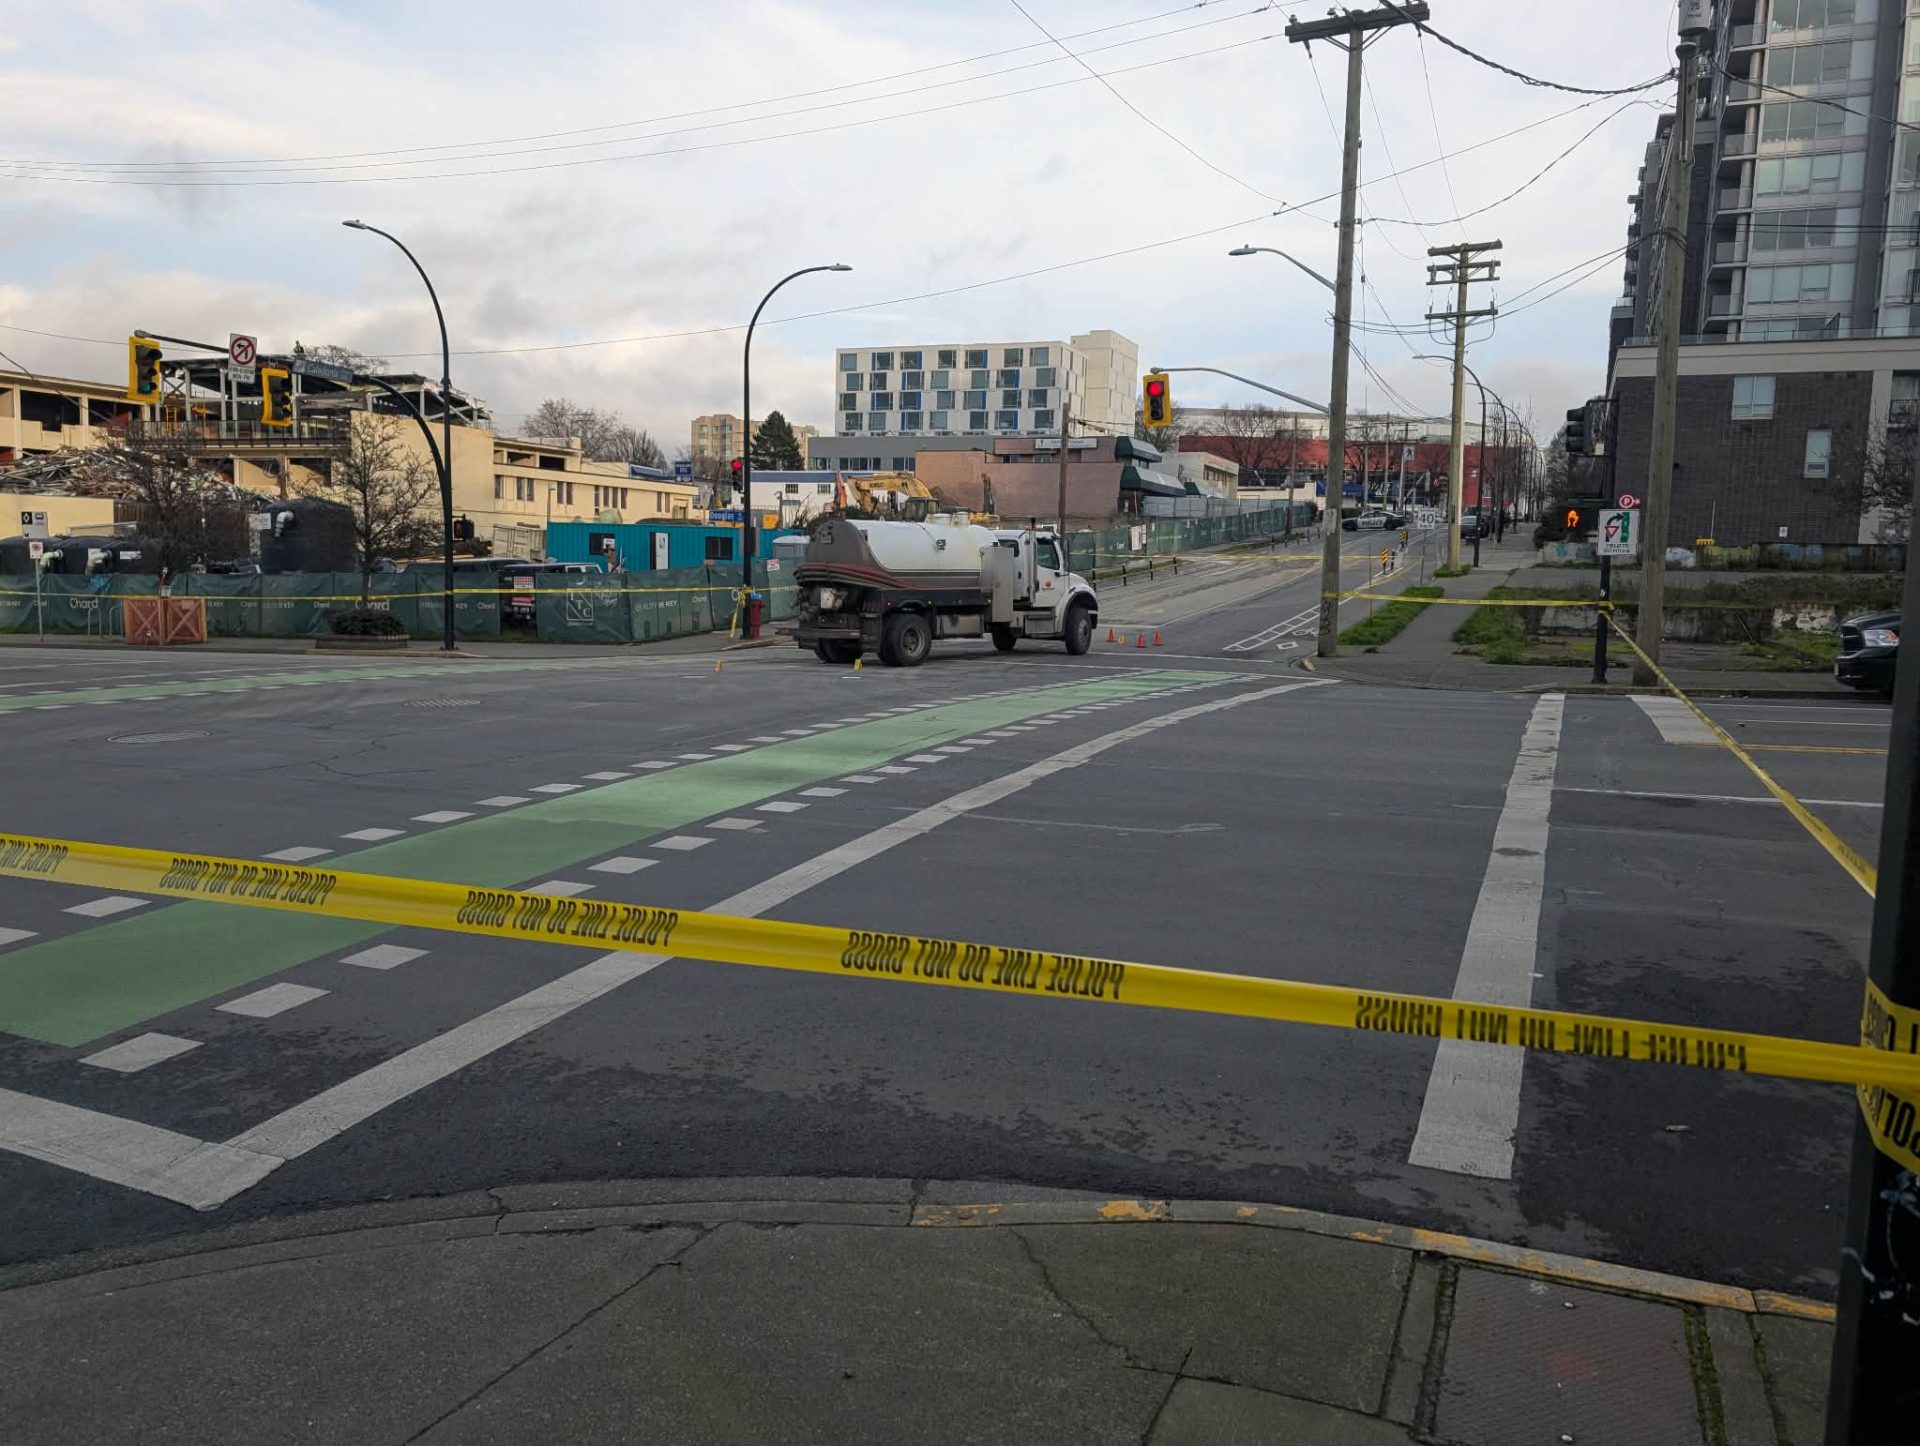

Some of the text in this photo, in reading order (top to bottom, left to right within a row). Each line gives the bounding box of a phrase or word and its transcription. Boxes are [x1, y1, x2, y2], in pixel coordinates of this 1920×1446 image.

[710, 510, 735, 522] Douglas
[1419, 513, 1434, 524] 40
[69, 596, 98, 609] Chard
[355, 598, 390, 612] Card
